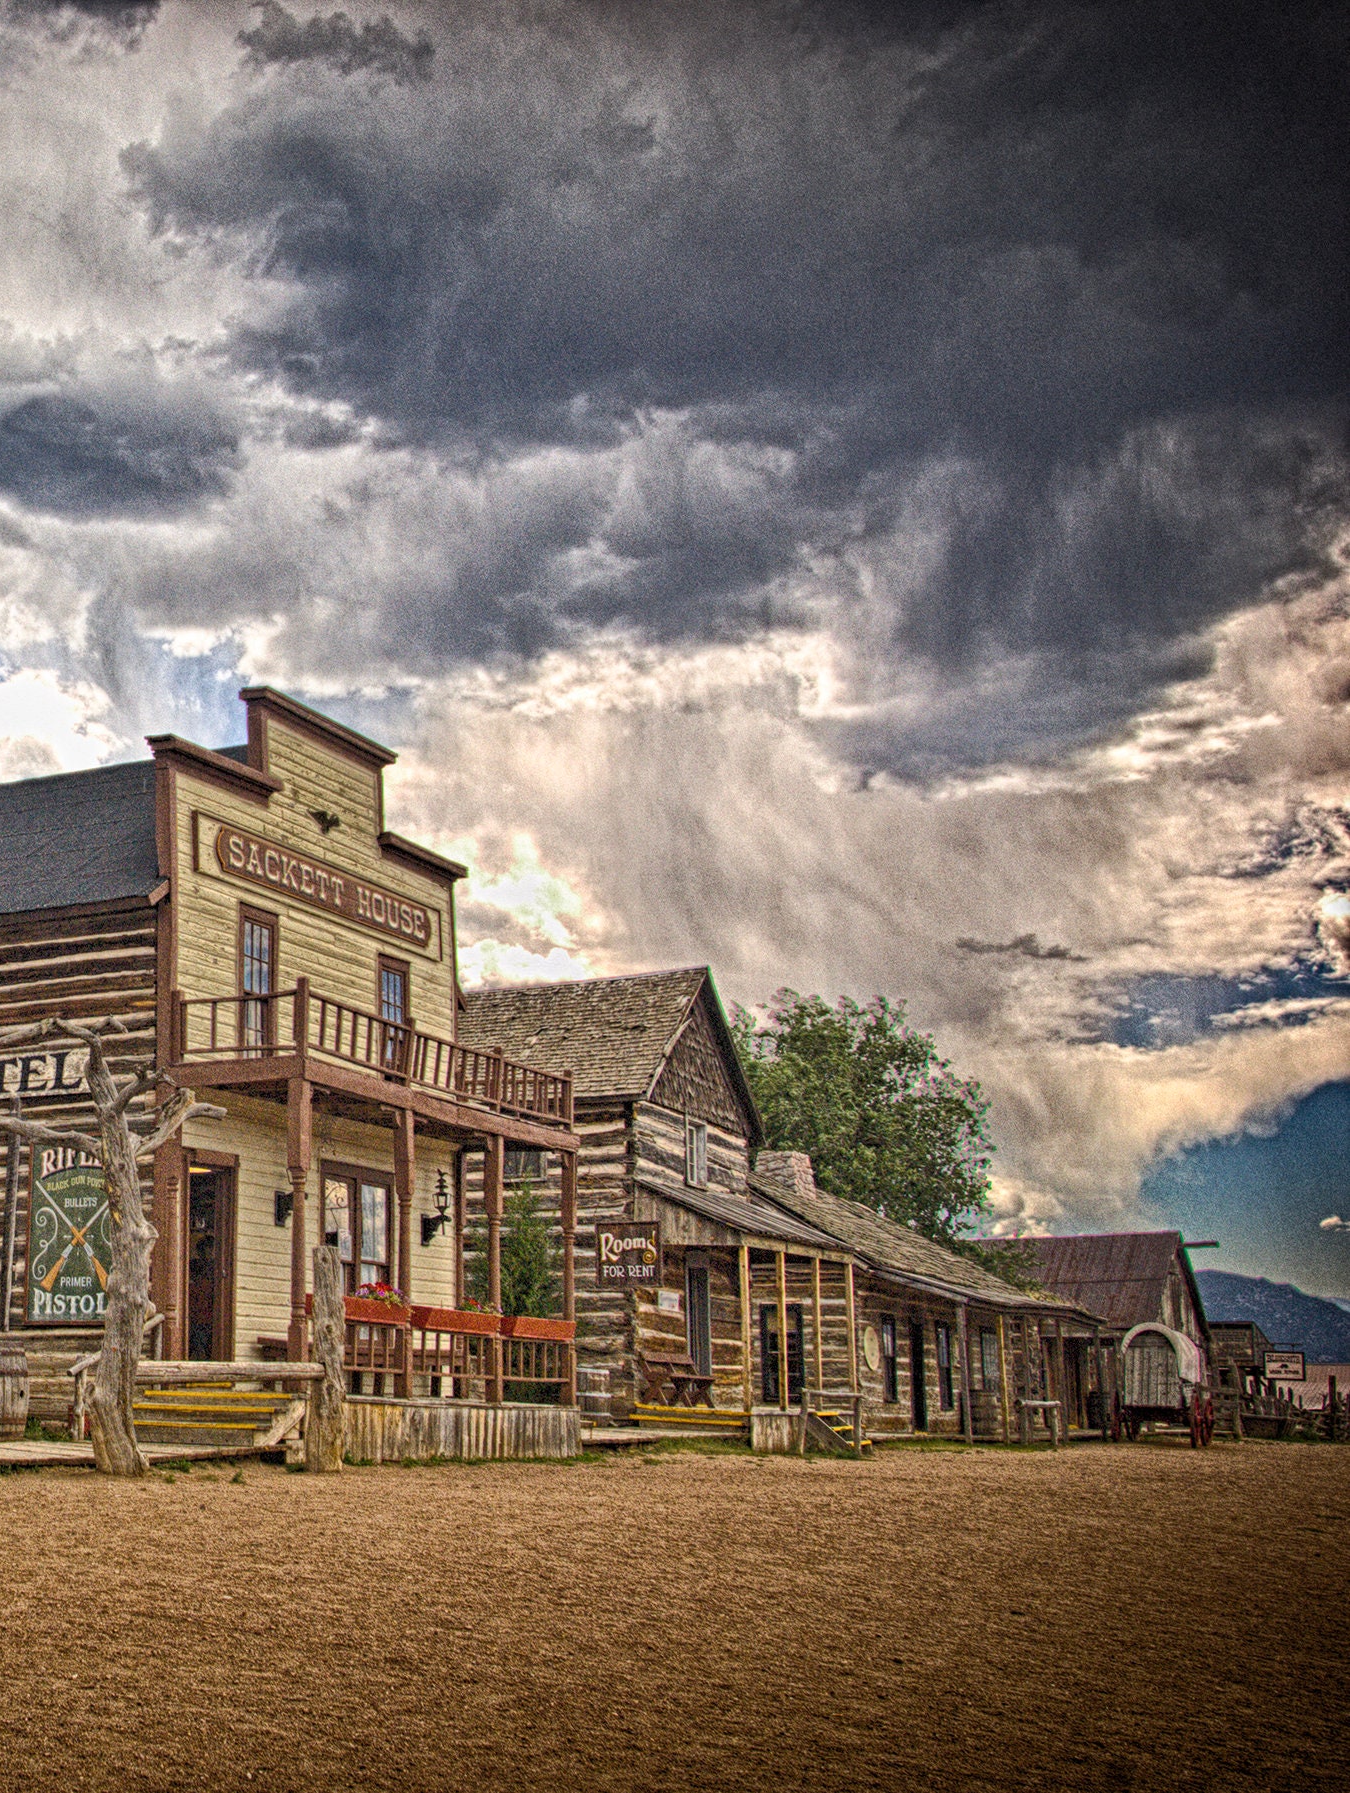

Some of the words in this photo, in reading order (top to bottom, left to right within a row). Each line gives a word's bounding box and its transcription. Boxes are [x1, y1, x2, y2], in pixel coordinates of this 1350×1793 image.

[229, 834, 345, 907] SACKETT
[356, 885, 426, 941] HOUSE
[41, 1146, 103, 1180] RIFL
[46, 1178, 70, 1192] BLACK
[63, 1197, 98, 1208] BULLETS
[603, 1265, 625, 1278] FOR
[627, 1265, 655, 1278] RENT
[60, 1276, 93, 1288] PRIMER
[32, 1287, 107, 1315] PISTOL
